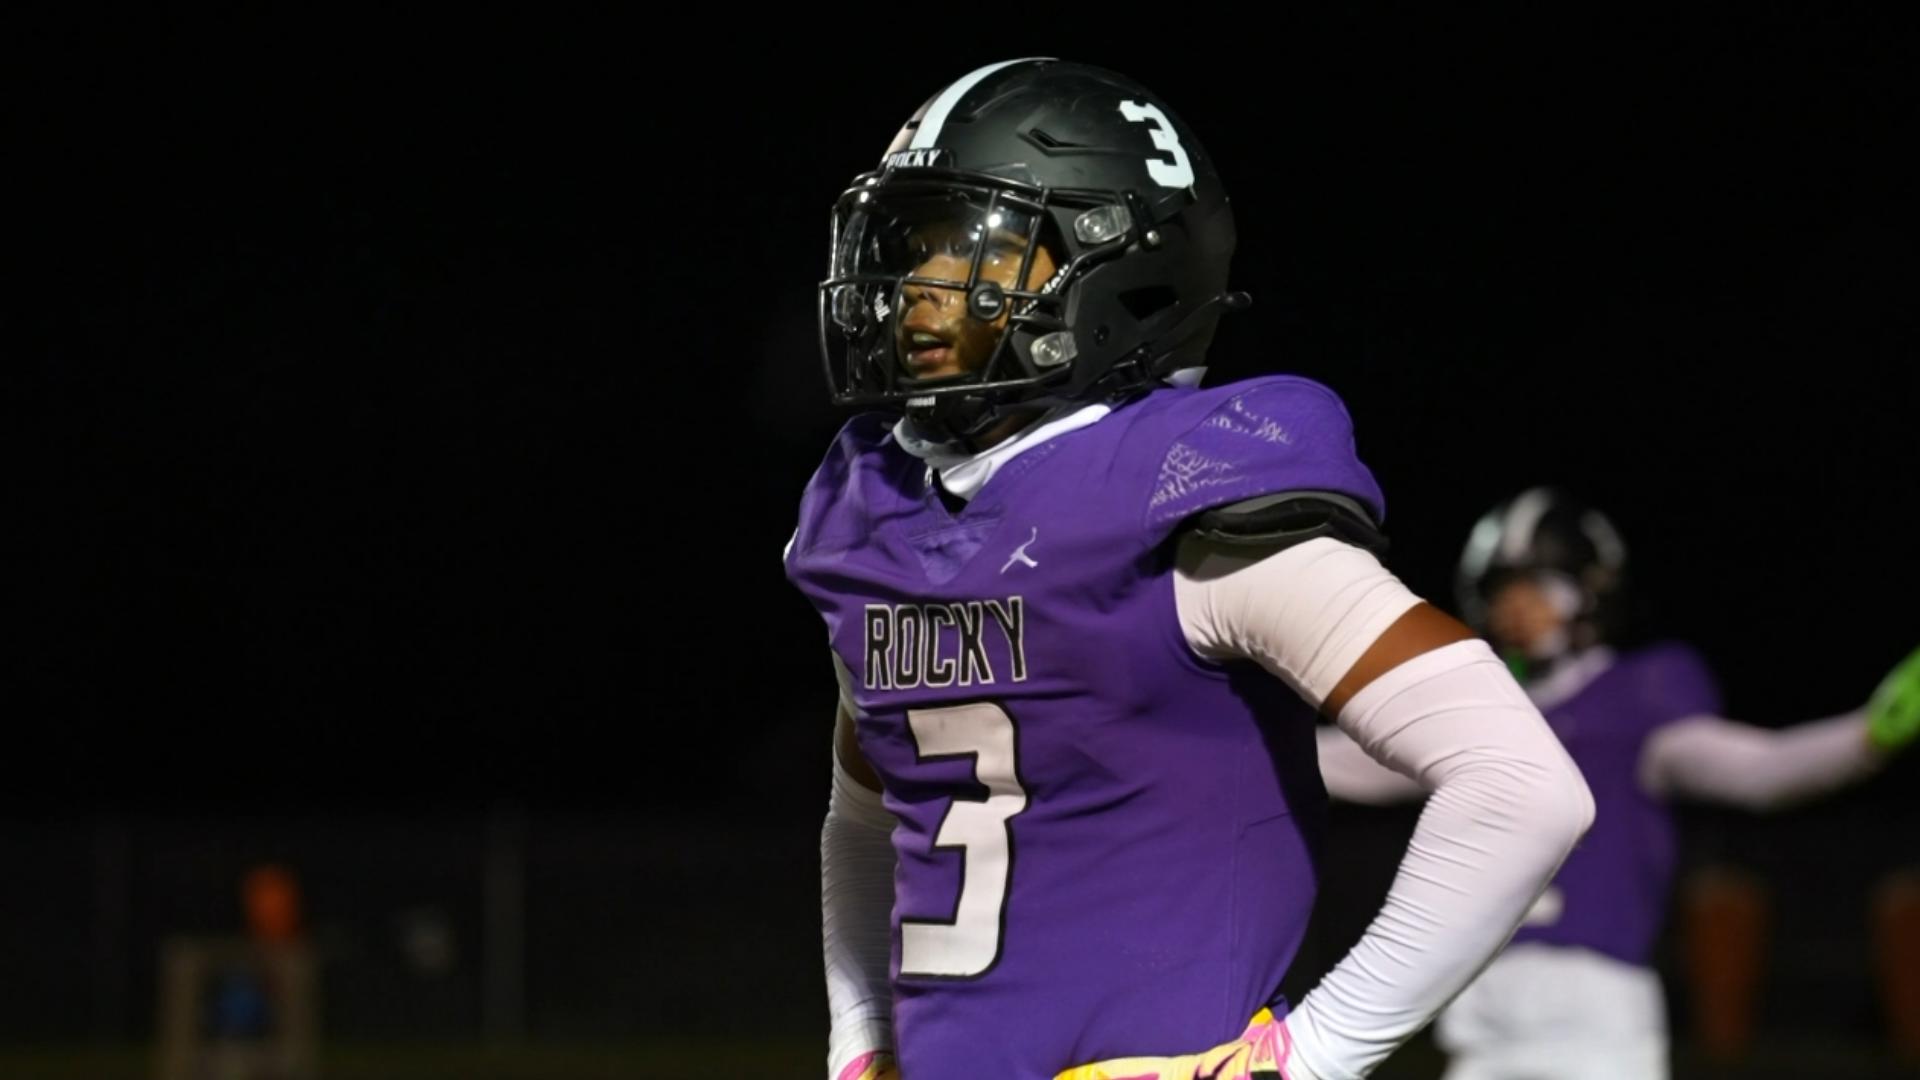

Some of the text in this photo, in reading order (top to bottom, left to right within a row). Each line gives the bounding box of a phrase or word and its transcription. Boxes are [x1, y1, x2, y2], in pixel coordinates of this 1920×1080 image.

[886, 148, 940, 168] ROCKY
[1118, 99, 1195, 188] 3
[864, 596, 1026, 689] ROCKY
[899, 702, 1027, 980] 3
